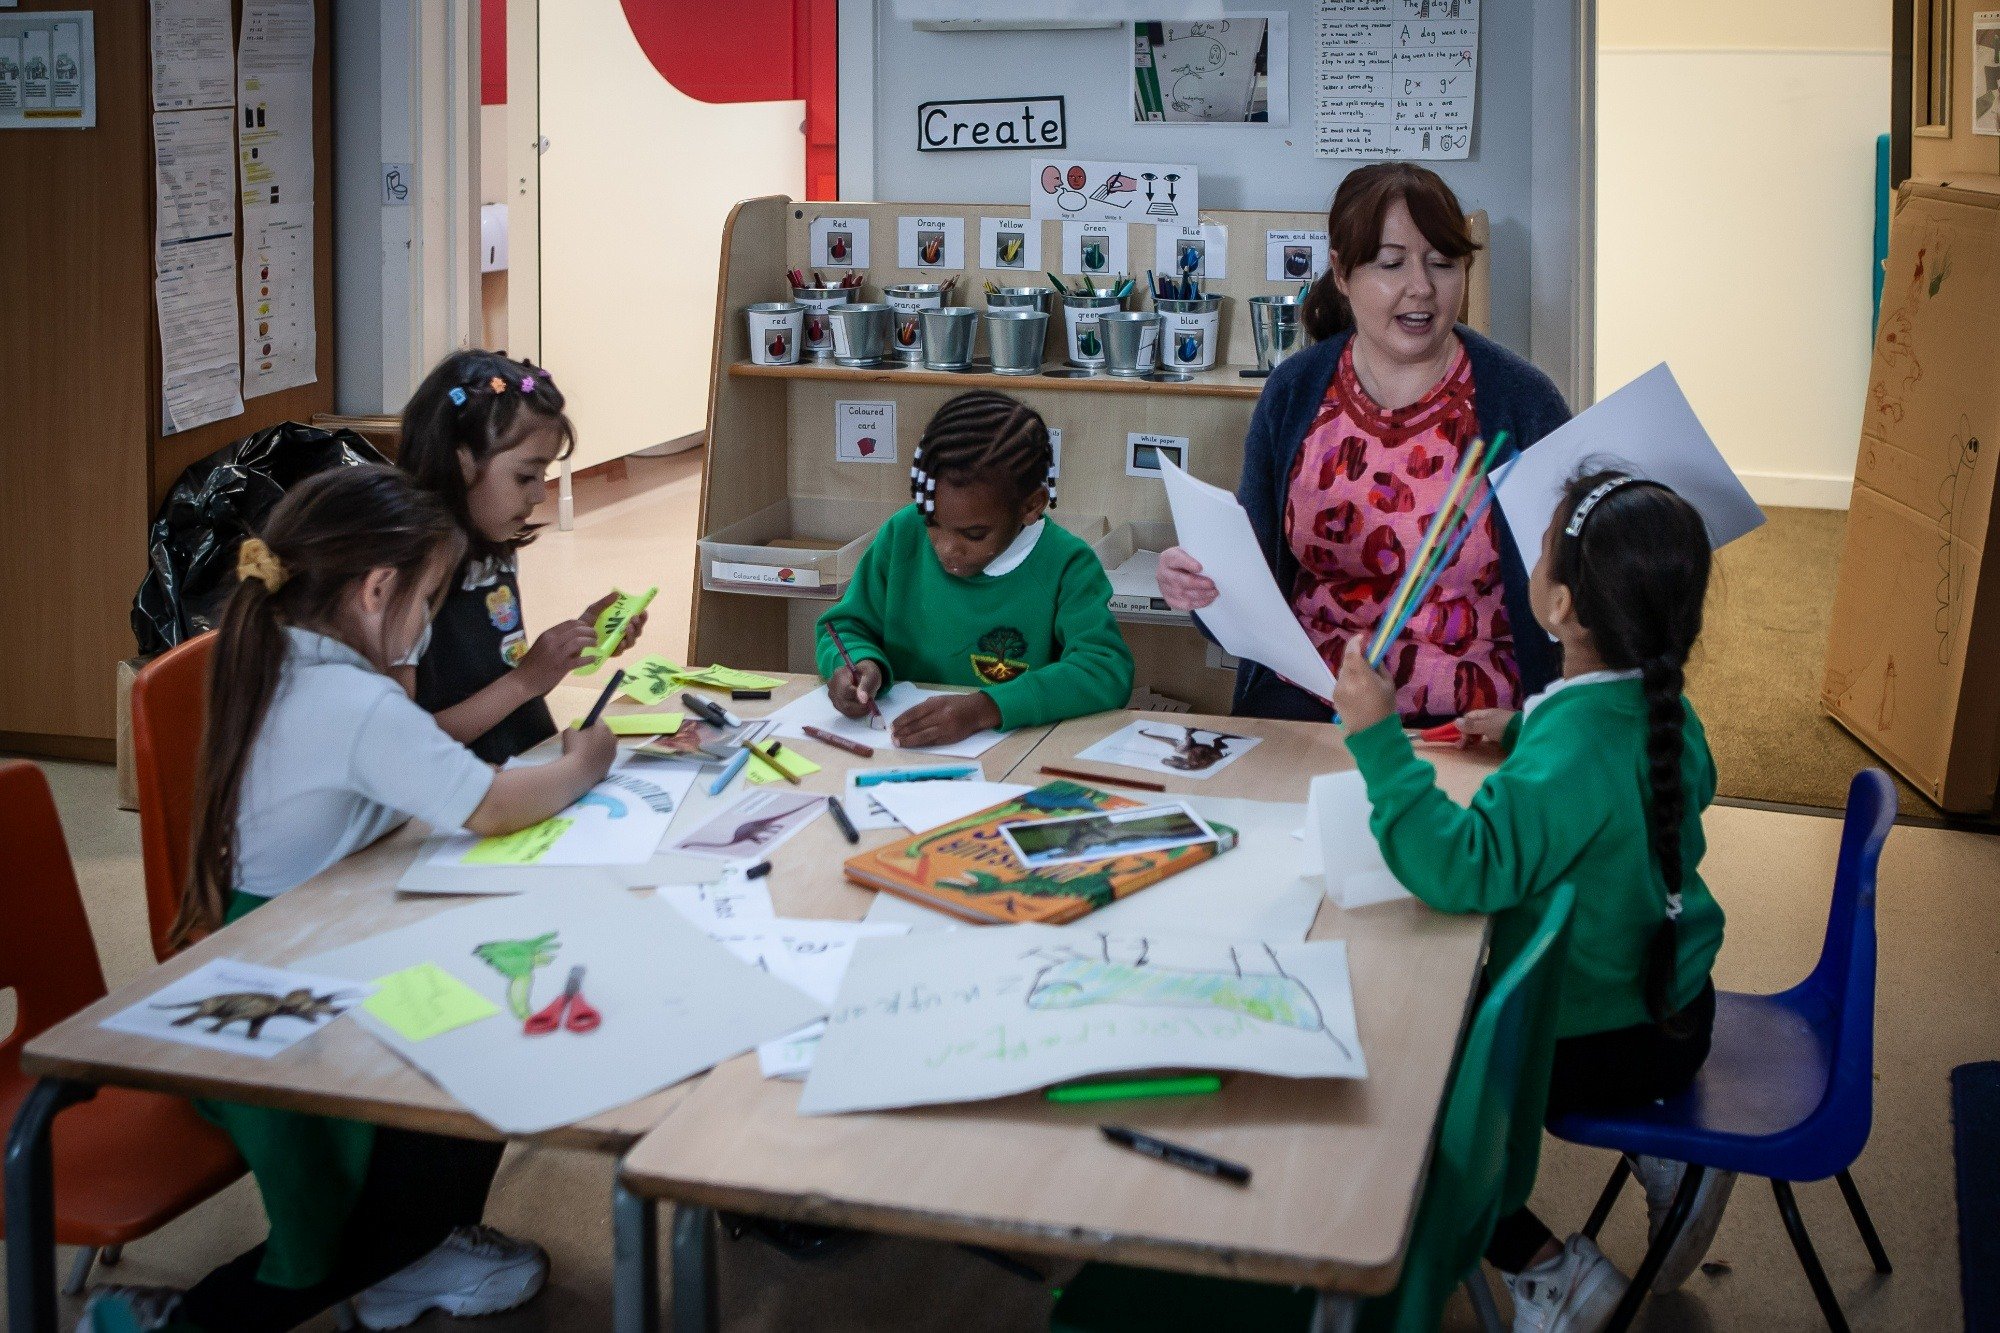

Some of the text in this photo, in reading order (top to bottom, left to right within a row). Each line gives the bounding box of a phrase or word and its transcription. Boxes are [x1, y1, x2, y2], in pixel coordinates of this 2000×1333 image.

[1400, 24, 1410, 39] A
[1421, 27, 1436, 44] dog
[924, 106, 1058, 146] Create
[1404, 126, 1415, 134] dog
[833, 220, 847, 228] Red
[918, 219, 946, 230] Orange
[999, 220, 1024, 228] Yellow
[1083, 224, 1107, 232] Green
[1183, 227, 1200, 235] Blue
[849, 407, 884, 416] Coloured
[733, 572, 778, 582] Coloured Card
